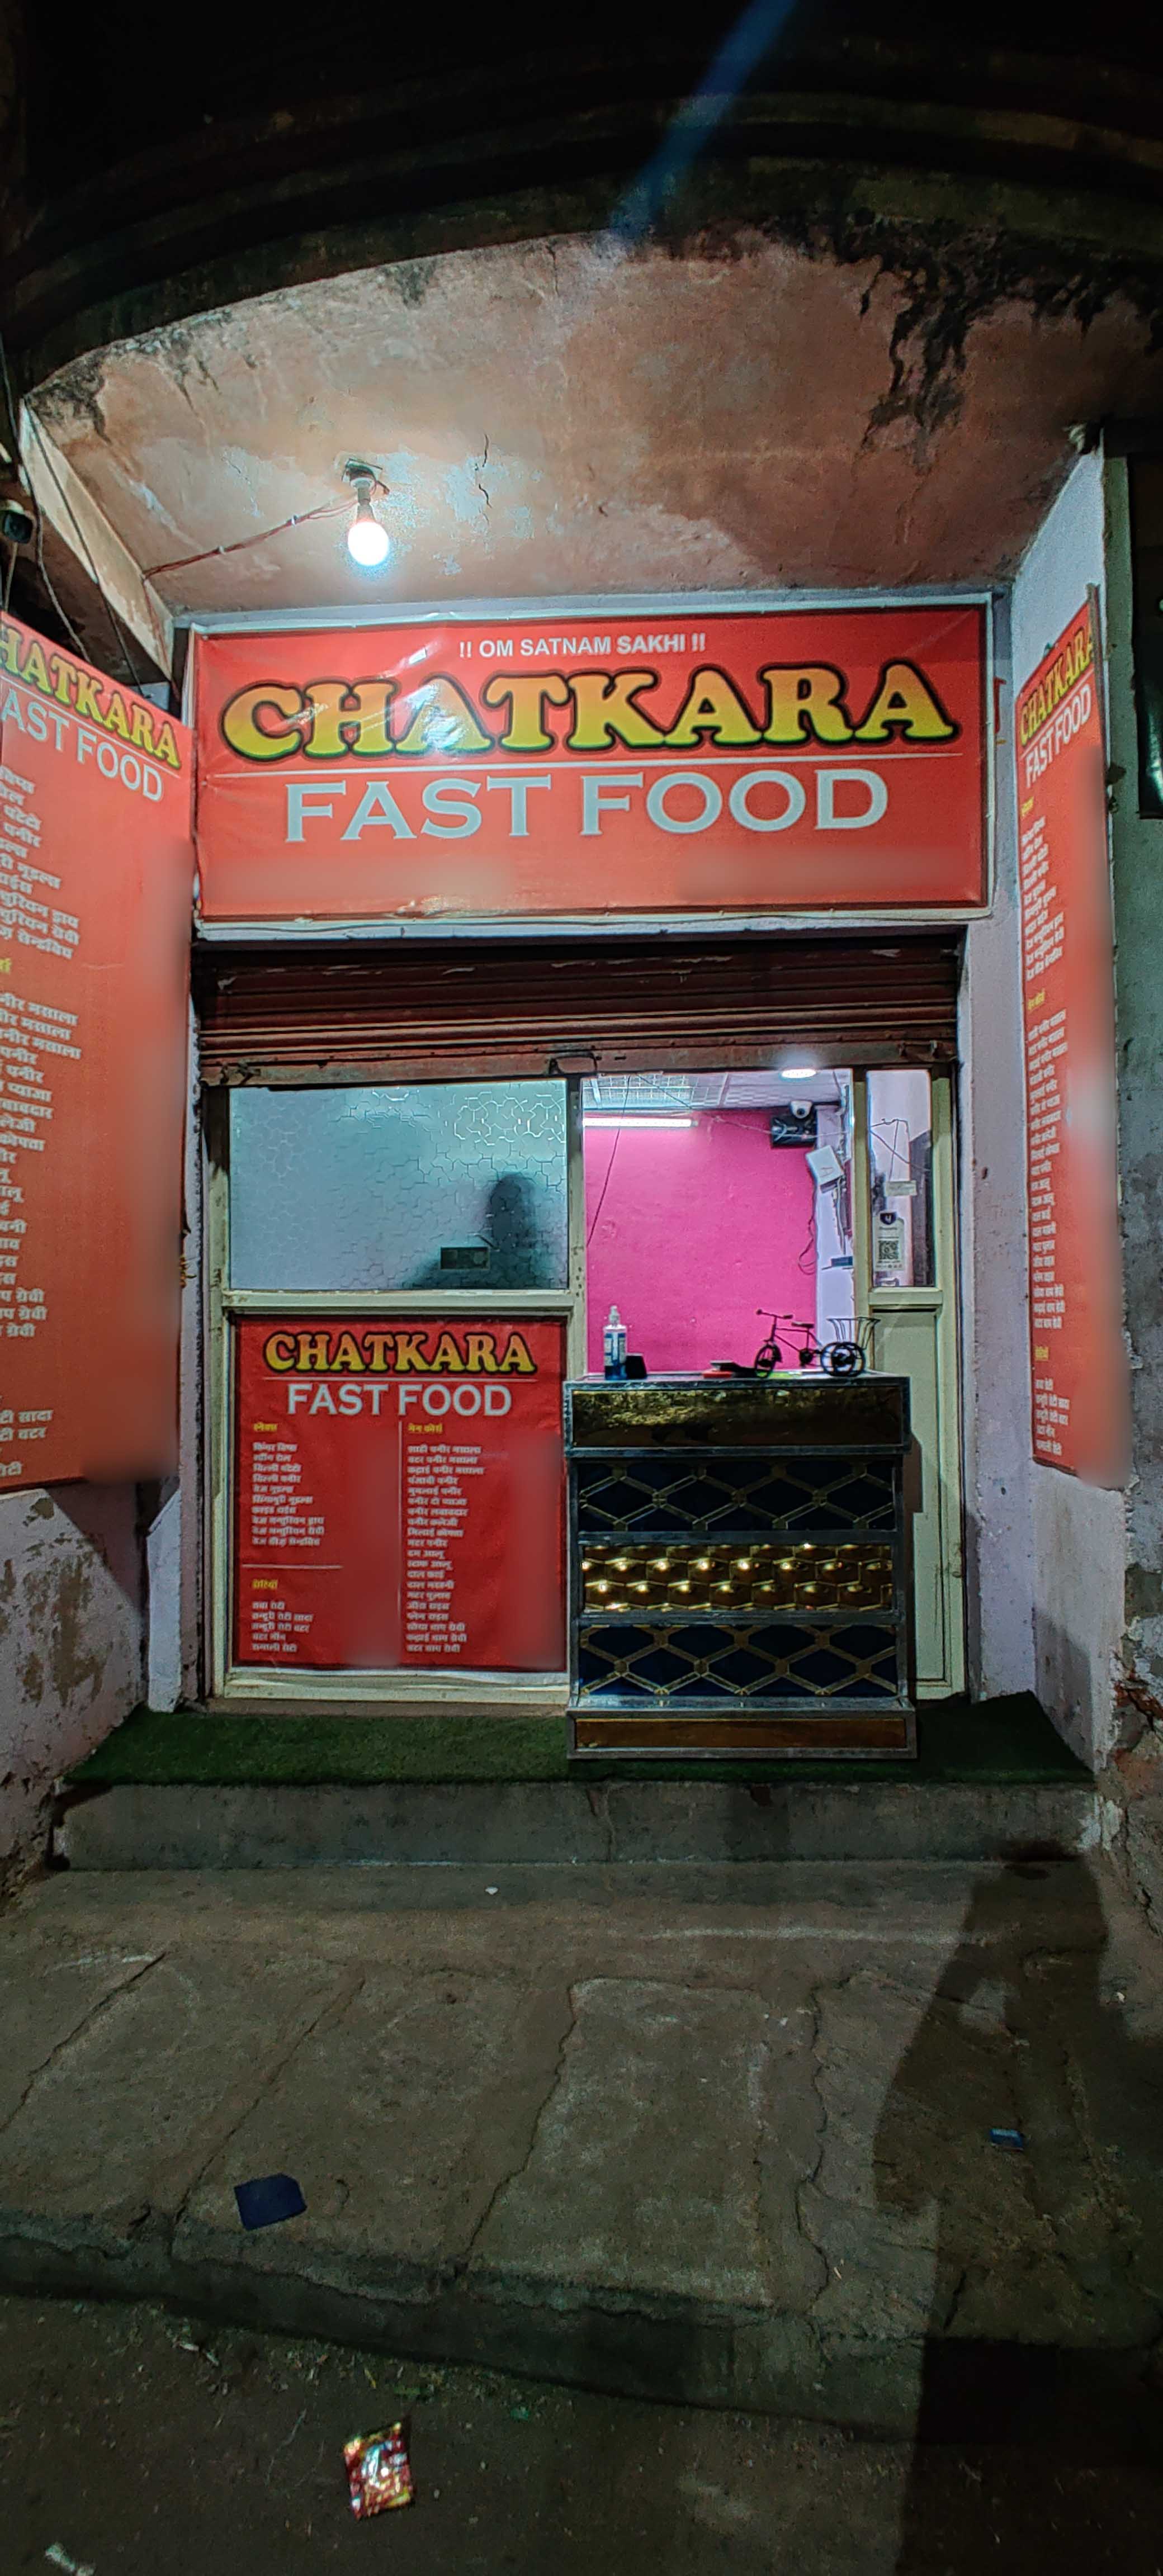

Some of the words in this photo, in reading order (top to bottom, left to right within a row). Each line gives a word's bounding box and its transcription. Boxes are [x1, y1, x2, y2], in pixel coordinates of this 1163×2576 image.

[479, 638, 514, 657] OM
[519, 636, 612, 657] SATNAM
[617, 634, 686, 655] SAKHI
[0, 624, 182, 770] HATKARA
[222, 659, 962, 761] CHATKARA
[1025, 727, 1054, 789] FAST
[1055, 683, 1091, 755] FOOD
[1, 688, 69, 754] AST
[77, 730, 163, 802] FOOD
[285, 773, 551, 843] FAST
[580, 769, 888, 836] FOOD
[263, 1330, 537, 1373] CHATKARA
[287, 1384, 389, 1415] FAST
[399, 1384, 512, 1416] FOOD
